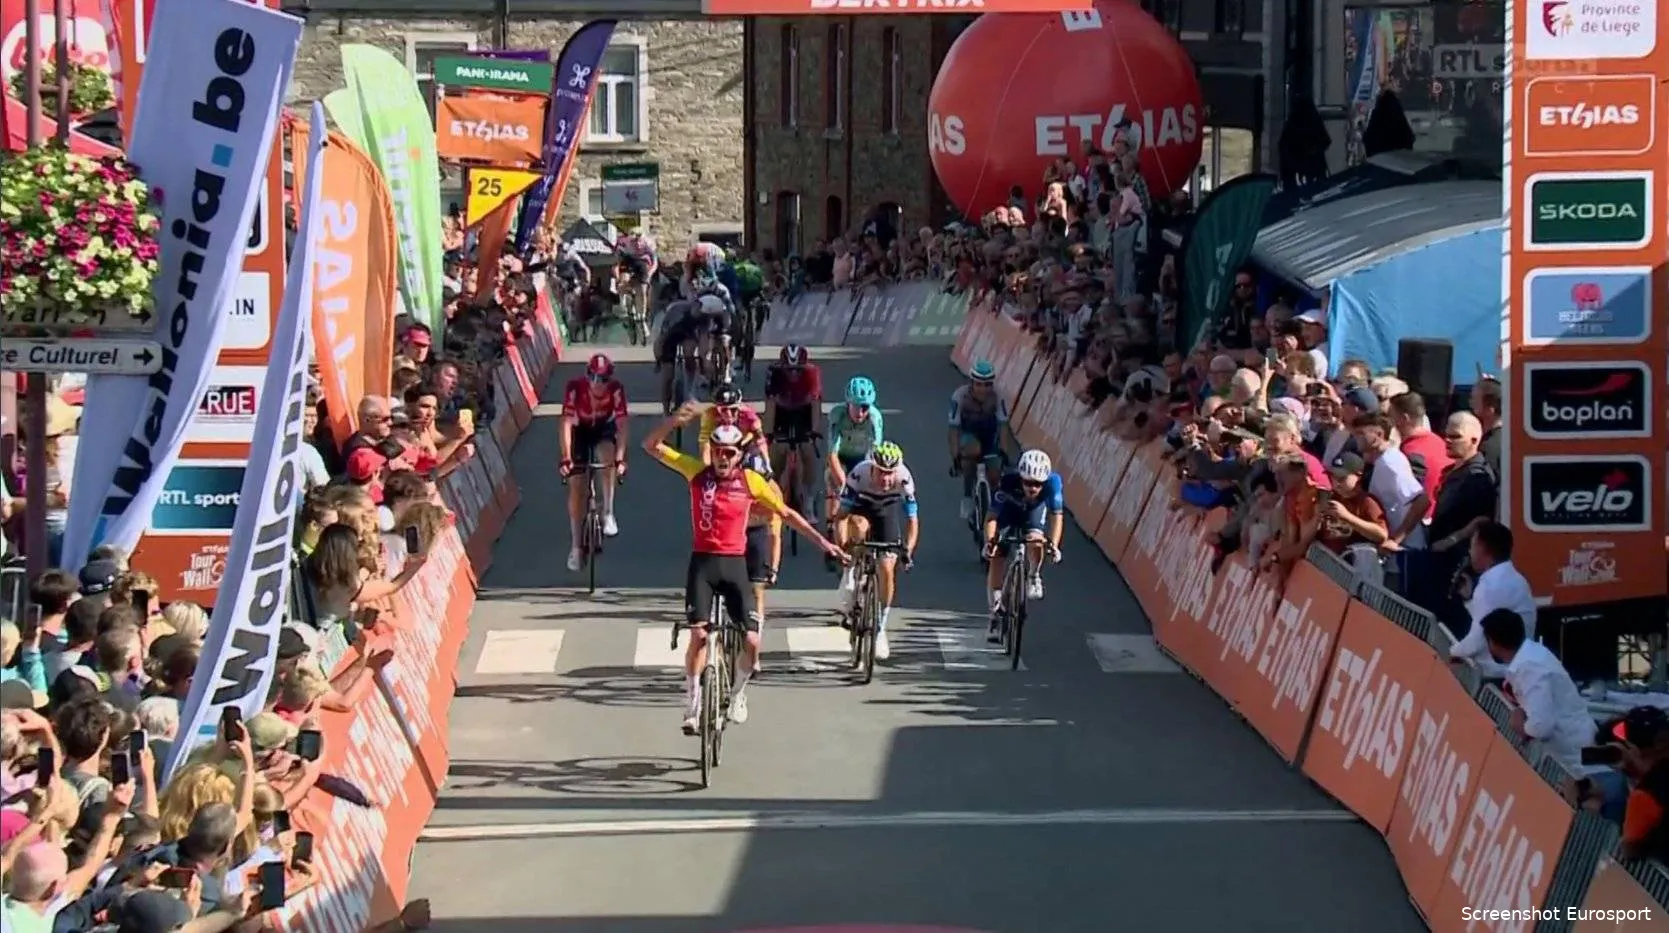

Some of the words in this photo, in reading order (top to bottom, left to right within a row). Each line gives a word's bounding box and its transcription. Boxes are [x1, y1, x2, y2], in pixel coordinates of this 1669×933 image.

[1581, 4, 1641, 16] Province
[1580, 22, 1599, 33] de
[477, 177, 502, 197] 25
[29, 345, 119, 365] Culturel
[1542, 401, 1633, 426] boplan
[160, 490, 191, 505] RTL
[1541, 485, 1634, 513] velo
